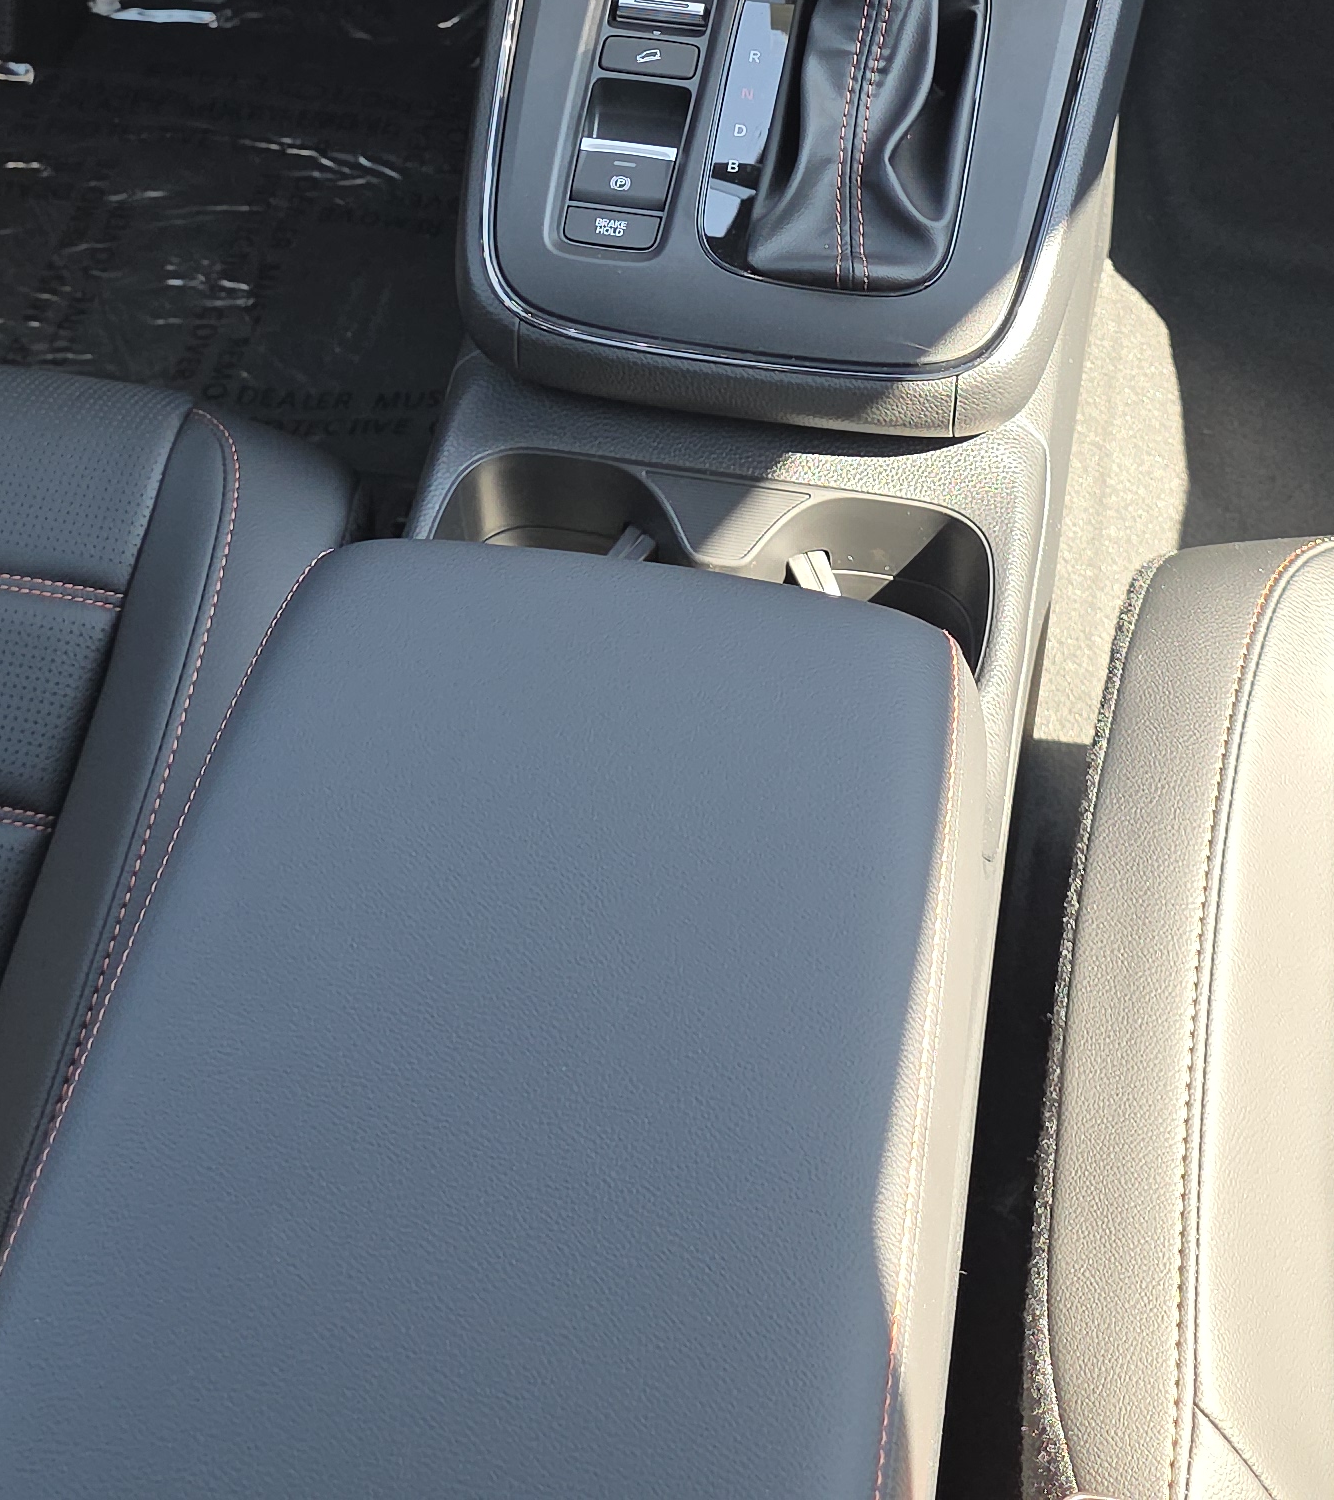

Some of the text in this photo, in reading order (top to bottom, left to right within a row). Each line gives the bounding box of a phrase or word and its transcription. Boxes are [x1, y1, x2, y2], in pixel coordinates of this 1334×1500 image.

[748, 50, 761, 63] R
[741, 87, 754, 100] N
[734, 124, 747, 137] D
[727, 160, 739, 173] B
[595, 217, 628, 230] BRAKE
[595, 226, 624, 237] HOLD
[236, 385, 445, 410] DEALER MUS
